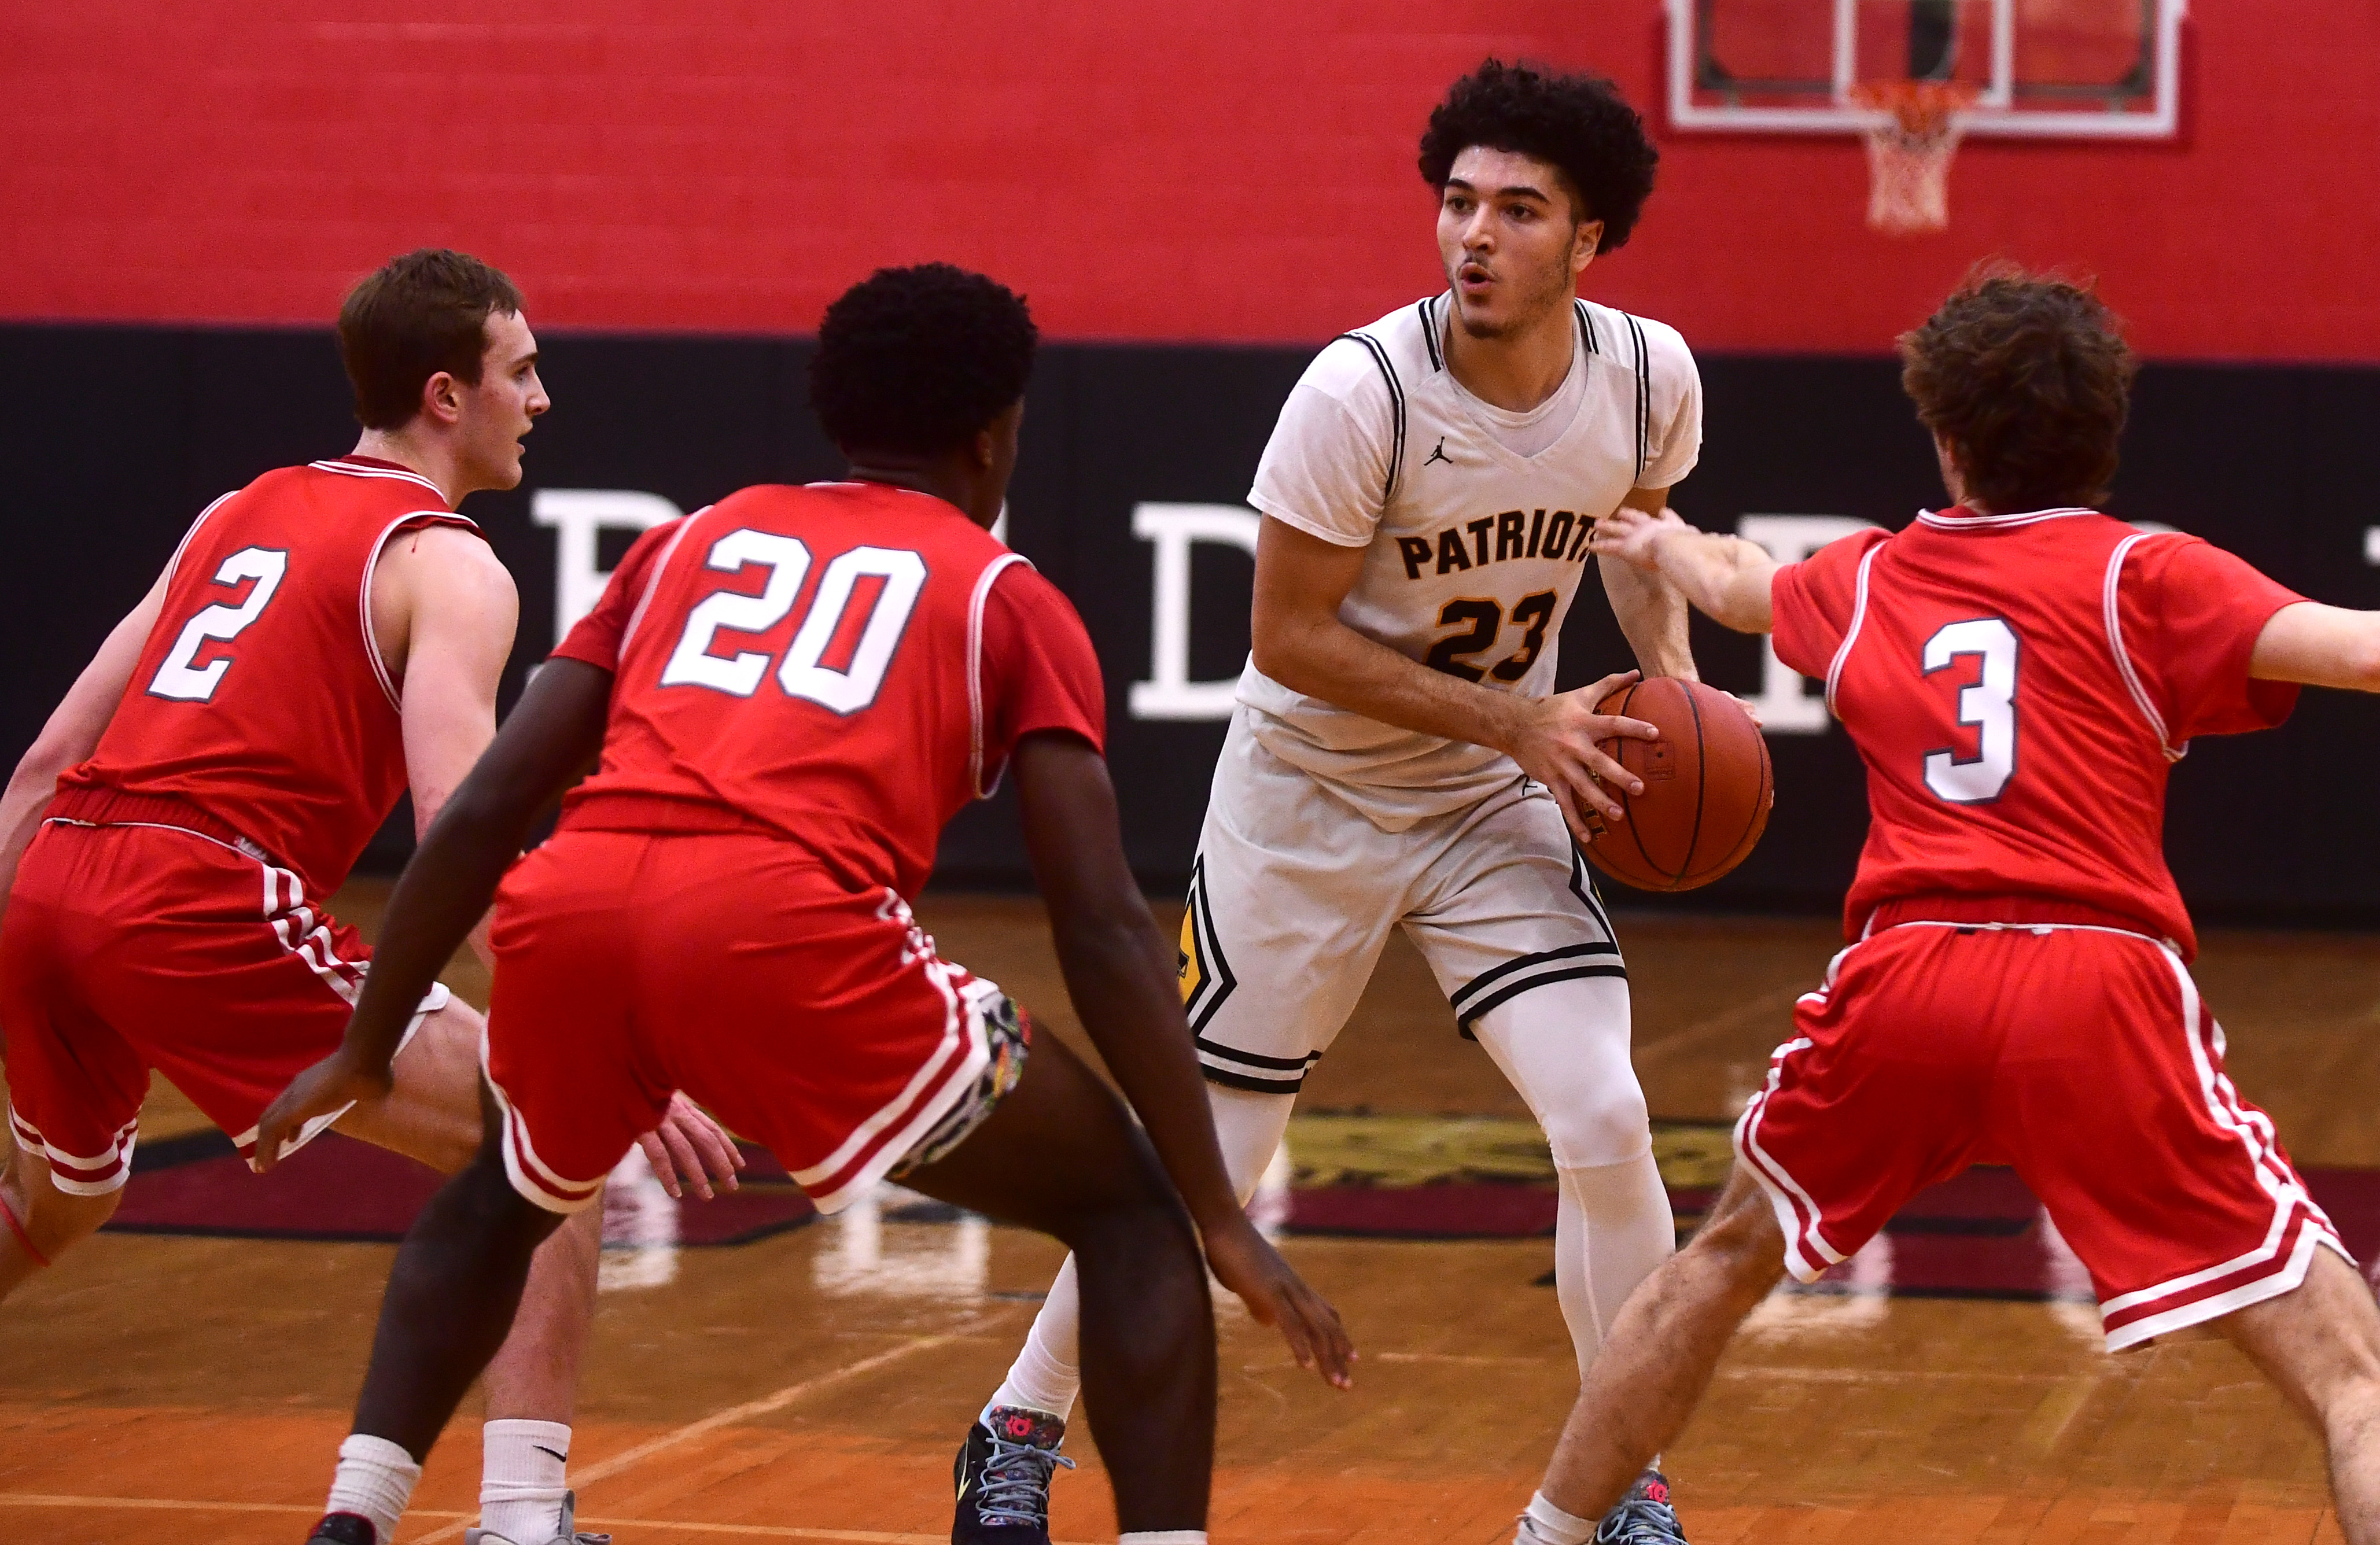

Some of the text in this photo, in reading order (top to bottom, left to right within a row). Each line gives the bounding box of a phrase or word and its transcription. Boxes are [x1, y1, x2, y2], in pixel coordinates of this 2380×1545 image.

[145, 545, 289, 703] 2
[657, 527, 930, 717] 20
[1423, 588, 1558, 684] 23
[1922, 617, 2022, 806] 3
